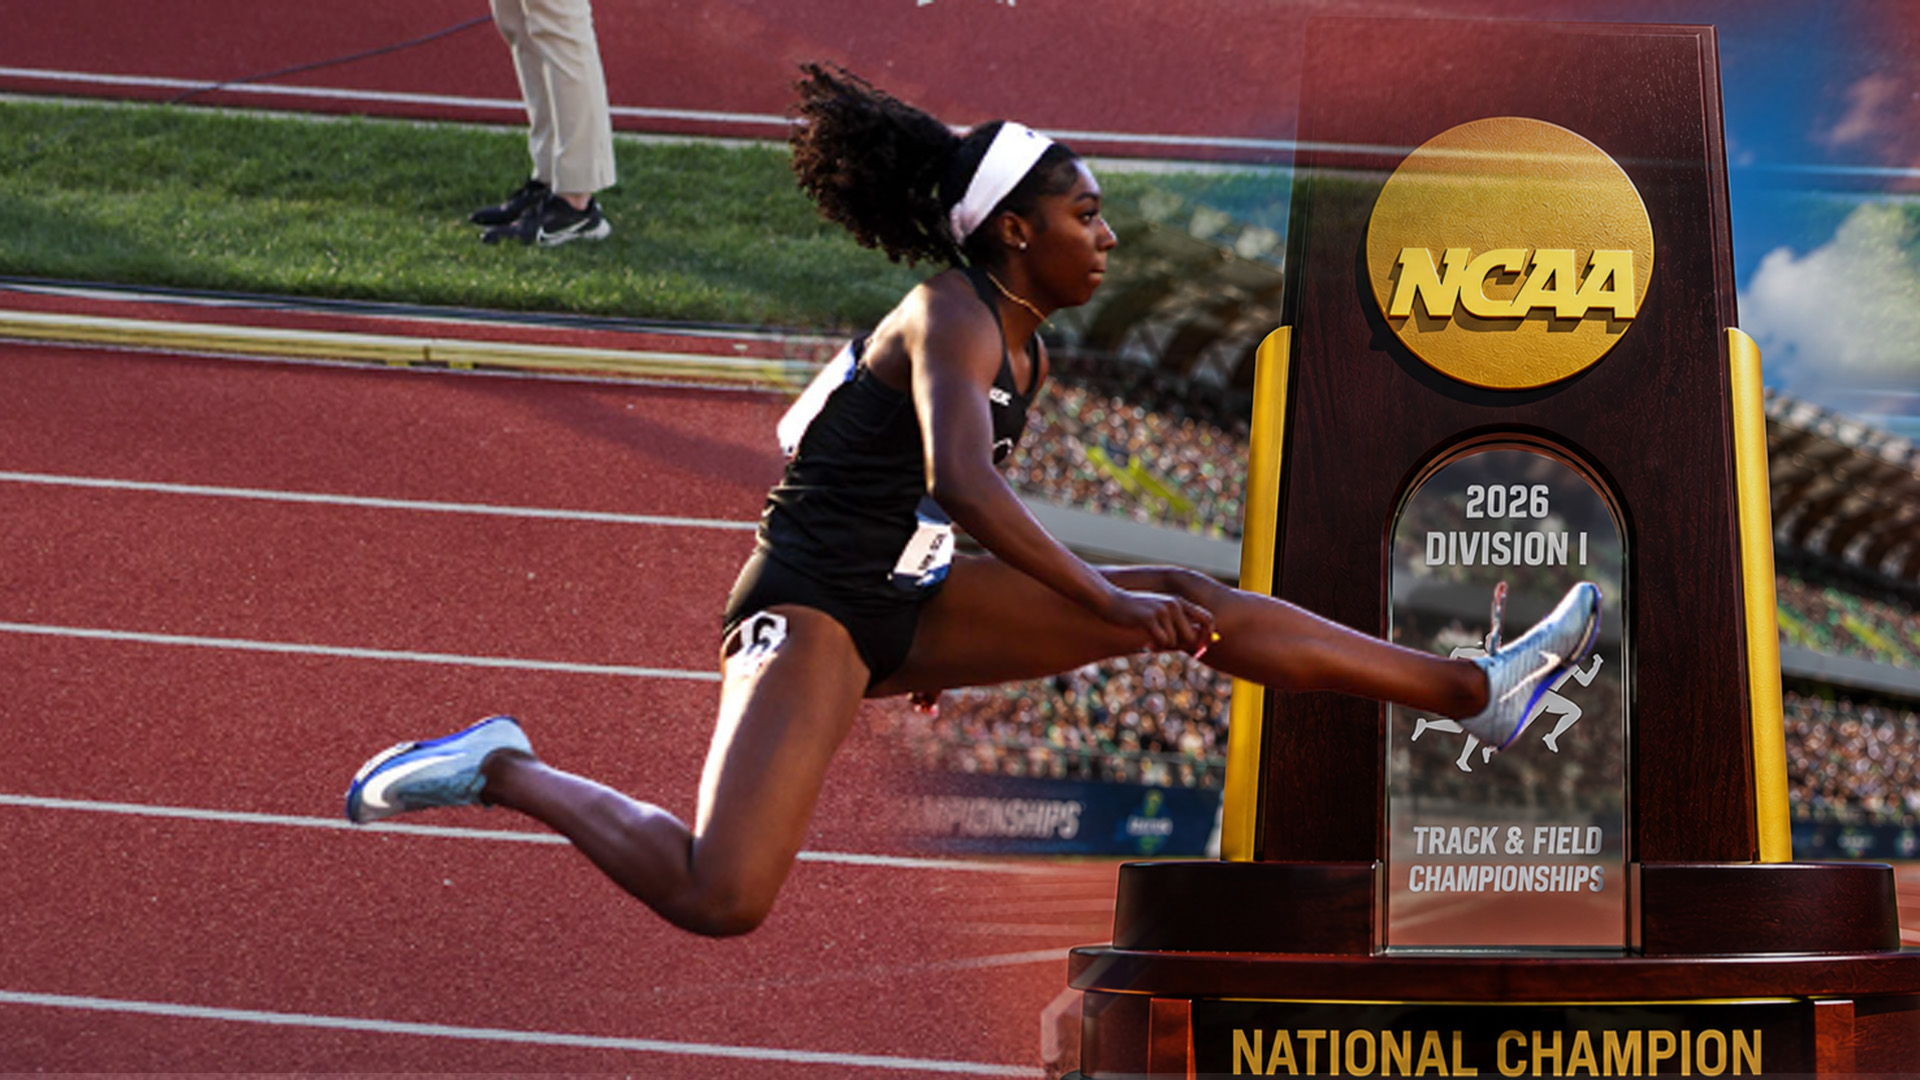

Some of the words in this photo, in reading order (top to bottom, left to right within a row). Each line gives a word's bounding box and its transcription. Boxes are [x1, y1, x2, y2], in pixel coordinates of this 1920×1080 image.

[1389, 247, 1637, 319] NCAA
[1466, 484, 1549, 518] 2026
[1426, 531, 1568, 566] DIVISION
[1579, 531, 1588, 566] I
[1413, 826, 1499, 855] TRACK
[1505, 826, 1525, 855] &
[1532, 826, 1603, 855] FIELD
[1409, 865, 1605, 892] CHAMPIONSHIPS
[1232, 1029, 1479, 1077] NATIONAL
[1496, 1029, 1762, 1077] CHAMPION
